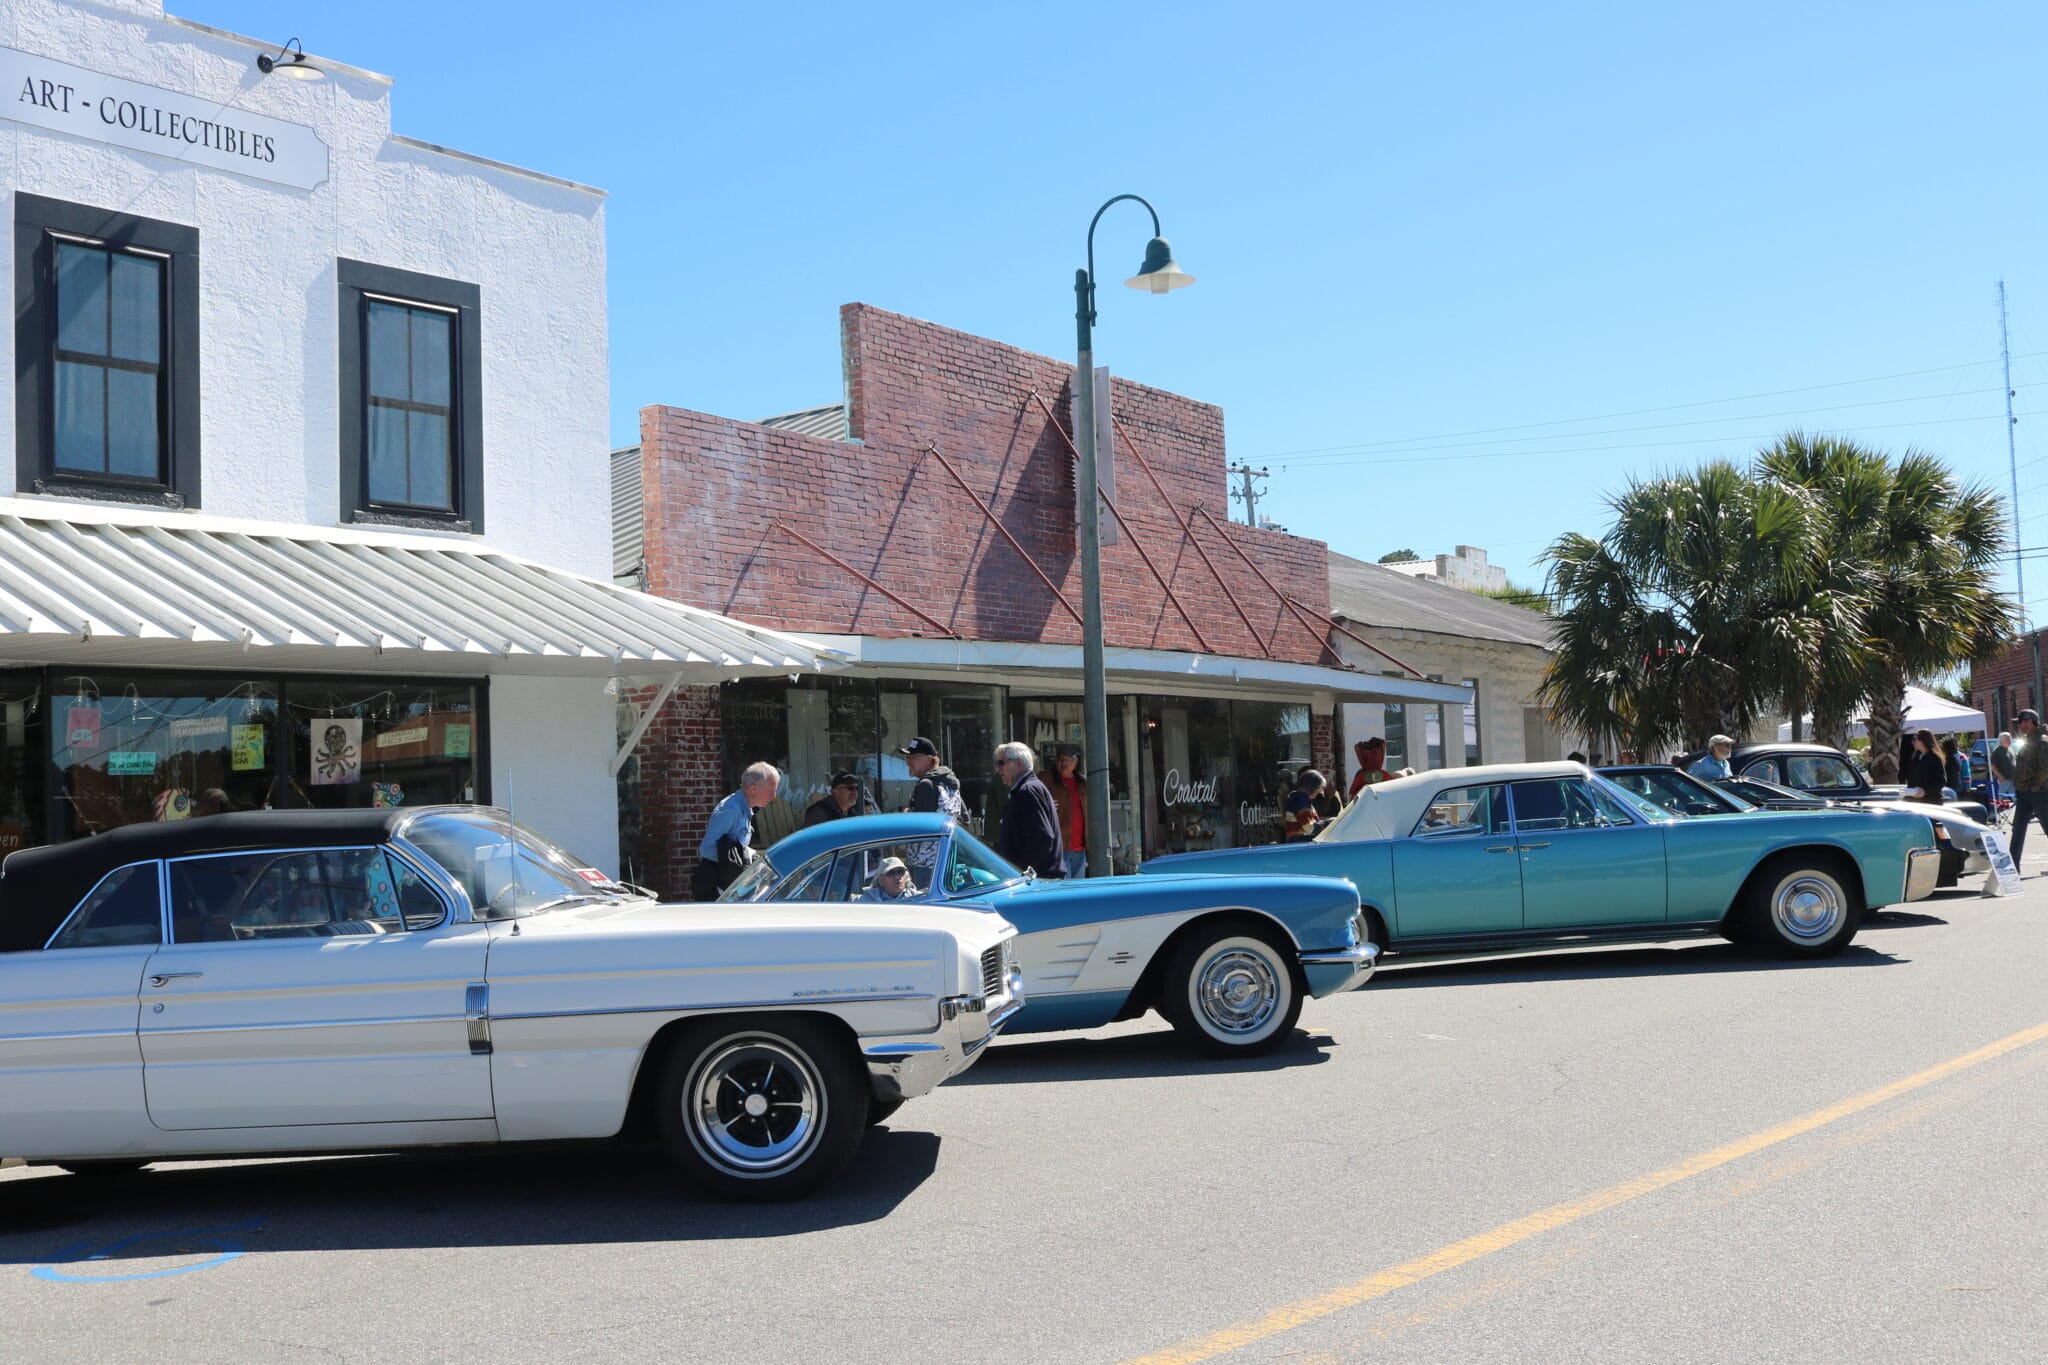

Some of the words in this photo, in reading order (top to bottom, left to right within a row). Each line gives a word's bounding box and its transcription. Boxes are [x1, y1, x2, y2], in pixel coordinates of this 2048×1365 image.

[19, 76, 74, 114] ART
[99, 96, 276, 163] COLLECTIBLES
[1163, 768, 1217, 807] Coastal
[0, 834, 19, 847] en
